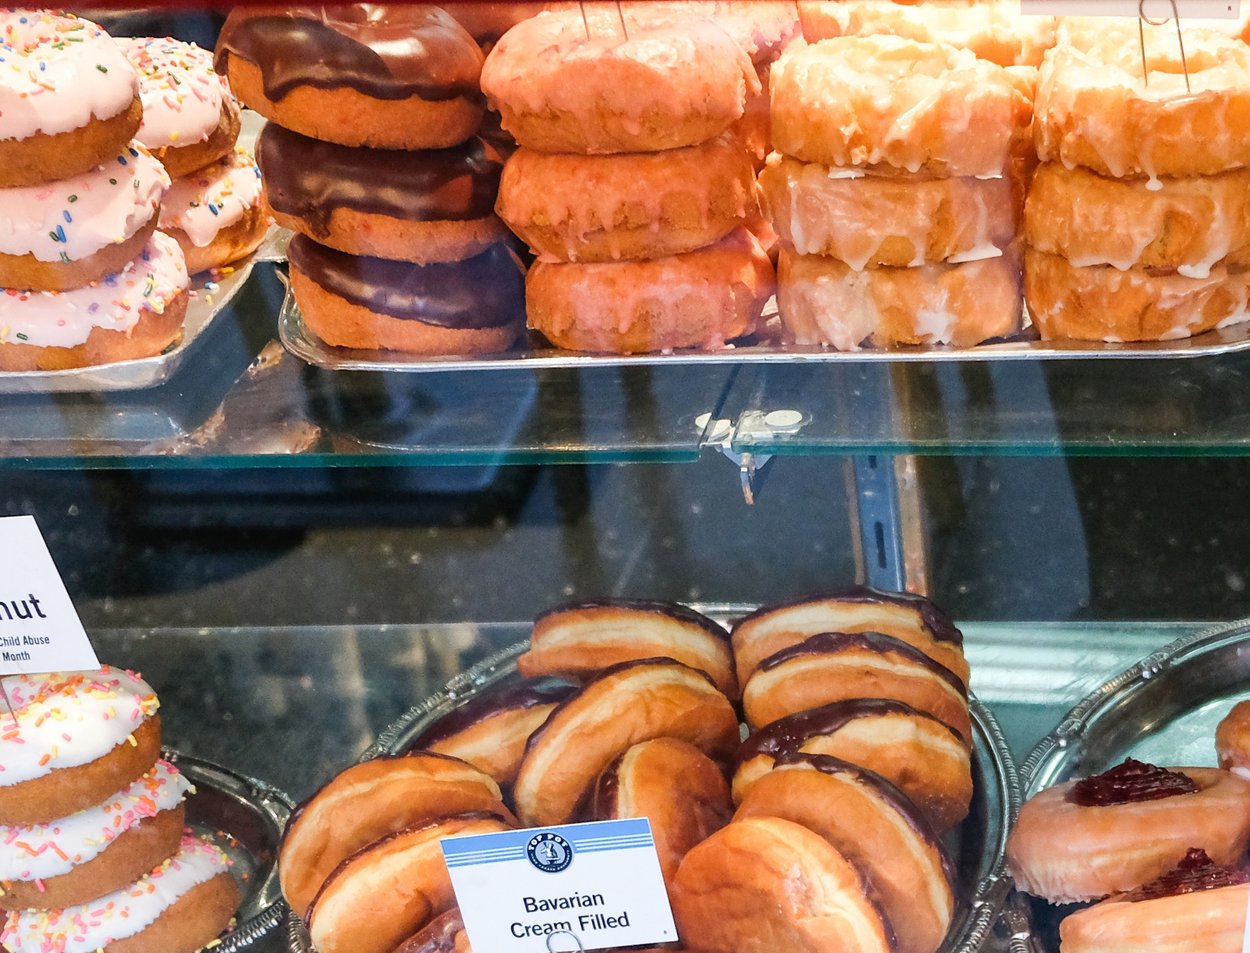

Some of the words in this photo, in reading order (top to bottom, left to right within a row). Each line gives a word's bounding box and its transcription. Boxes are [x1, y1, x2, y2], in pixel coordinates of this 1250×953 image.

[23, 635, 50, 645] Abuse
[2, 651, 31, 661] Month
[523, 891, 605, 913] Bavarian
[510, 920, 572, 938] Cream
[578, 911, 630, 932] Filled
